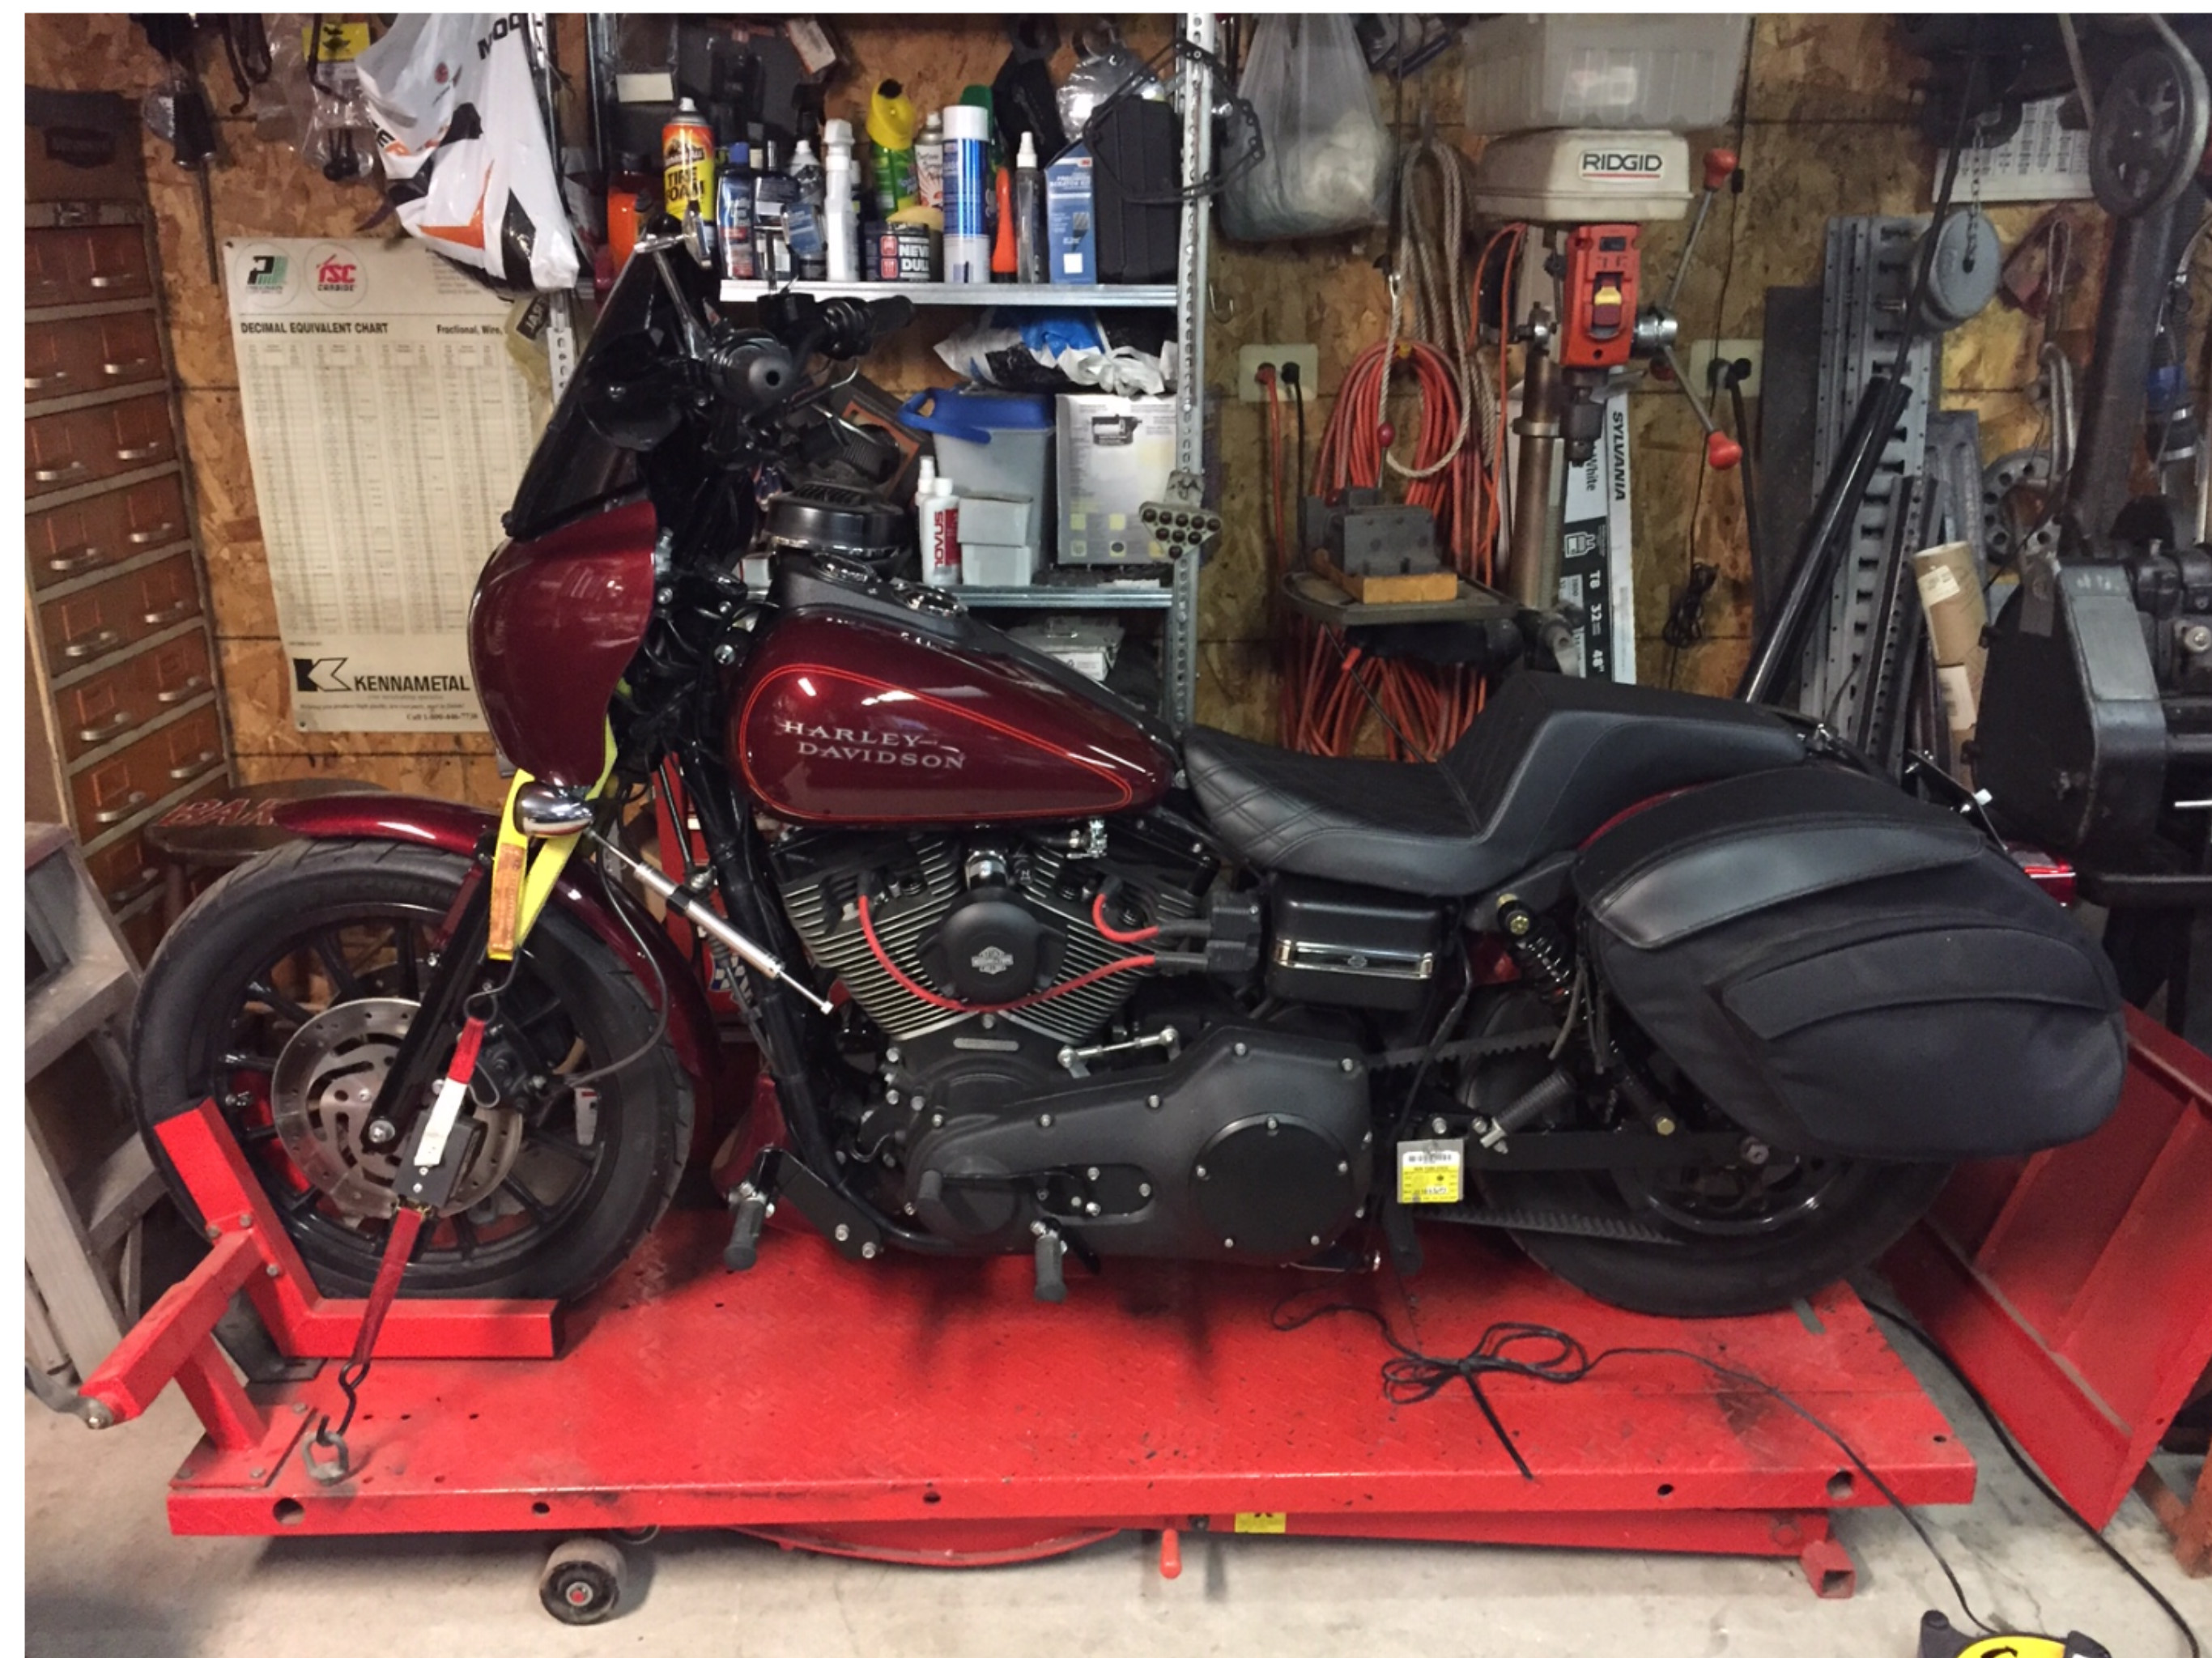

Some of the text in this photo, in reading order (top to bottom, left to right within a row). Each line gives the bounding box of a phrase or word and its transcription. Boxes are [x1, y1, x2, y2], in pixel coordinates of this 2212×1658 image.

[1582, 154, 1662, 171] RIDGID
[668, 166, 698, 185] TIRE
[241, 322, 388, 334] DECIMAL EQUIVALENT CHART
[436, 325, 504, 335] Fractional, Wire,
[1613, 410, 1626, 501] SYLVANIA
[1589, 570, 1601, 589] T8
[1591, 603, 1602, 623] 32
[354, 675, 470, 691] KENNAMETAL
[797, 741, 965, 769] DAVIDSON
